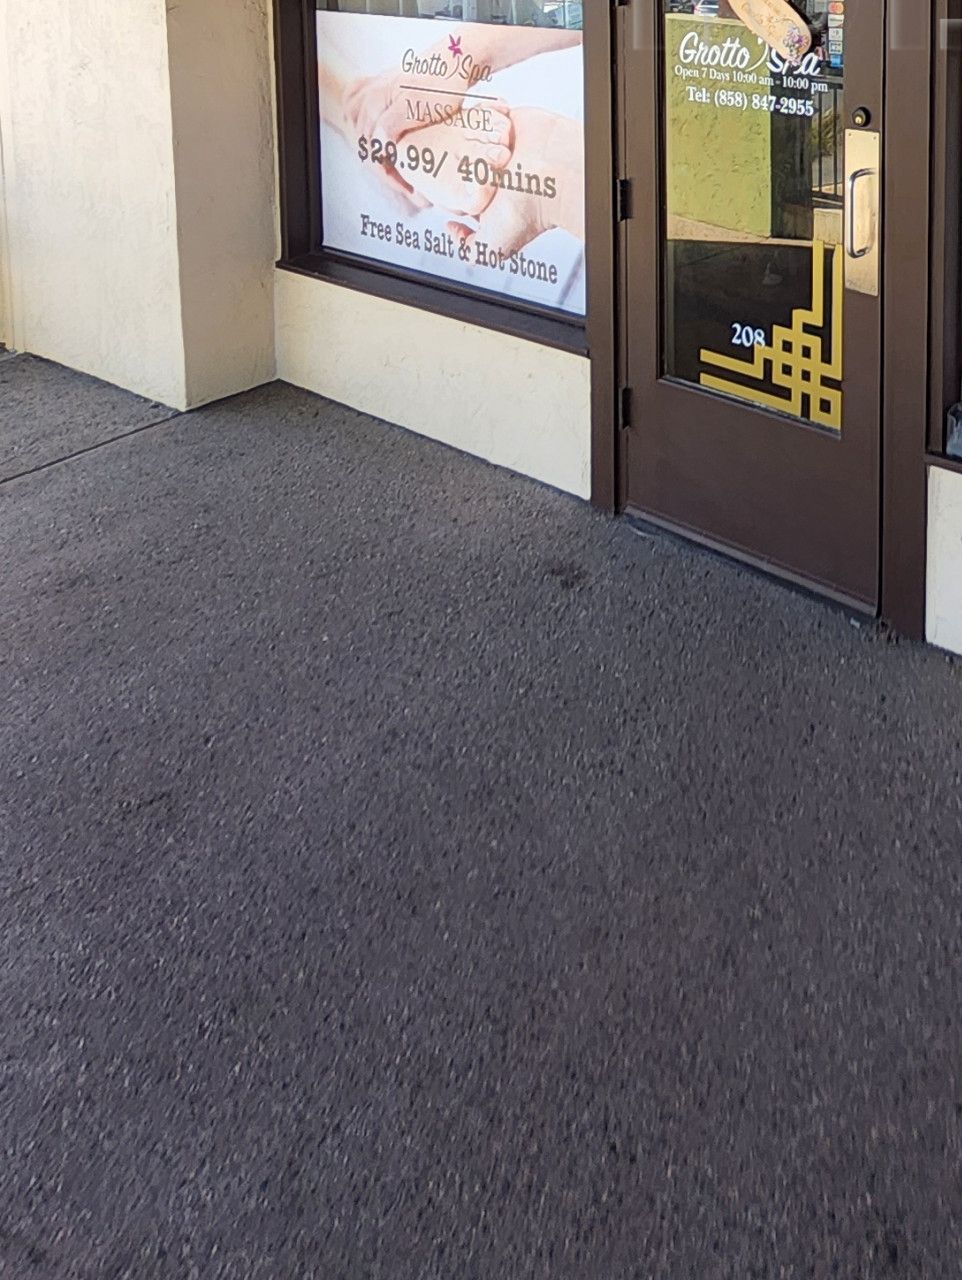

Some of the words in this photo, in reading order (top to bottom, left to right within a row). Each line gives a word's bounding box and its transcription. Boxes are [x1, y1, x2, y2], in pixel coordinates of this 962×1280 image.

[402, 48, 449, 77] Grotto
[459, 54, 493, 83] Spa
[679, 31, 750, 68] Grotto
[674, 64, 699, 80] Open
[701, 67, 708, 77] 7
[710, 70, 730, 83] Days
[733, 71, 757, 84] 10:00
[758, 77, 774, 86] am
[782, 76, 809, 89] 10:00
[811, 82, 828, 94] pm
[405, 99, 494, 132] MASSAGE
[685, 86, 710, 103] Tel:
[714, 89, 747, 111] (858)
[752, 94, 814, 116] 847-2955
[457, 155, 557, 199] 40mins
[361, 214, 392, 241] Free
[396, 222, 420, 250] Sea
[424, 229, 454, 258] Salt
[459, 237, 471, 262] &
[475, 241, 505, 270] Hot
[510, 250, 558, 284] Stone
[731, 323, 766, 347] 208
